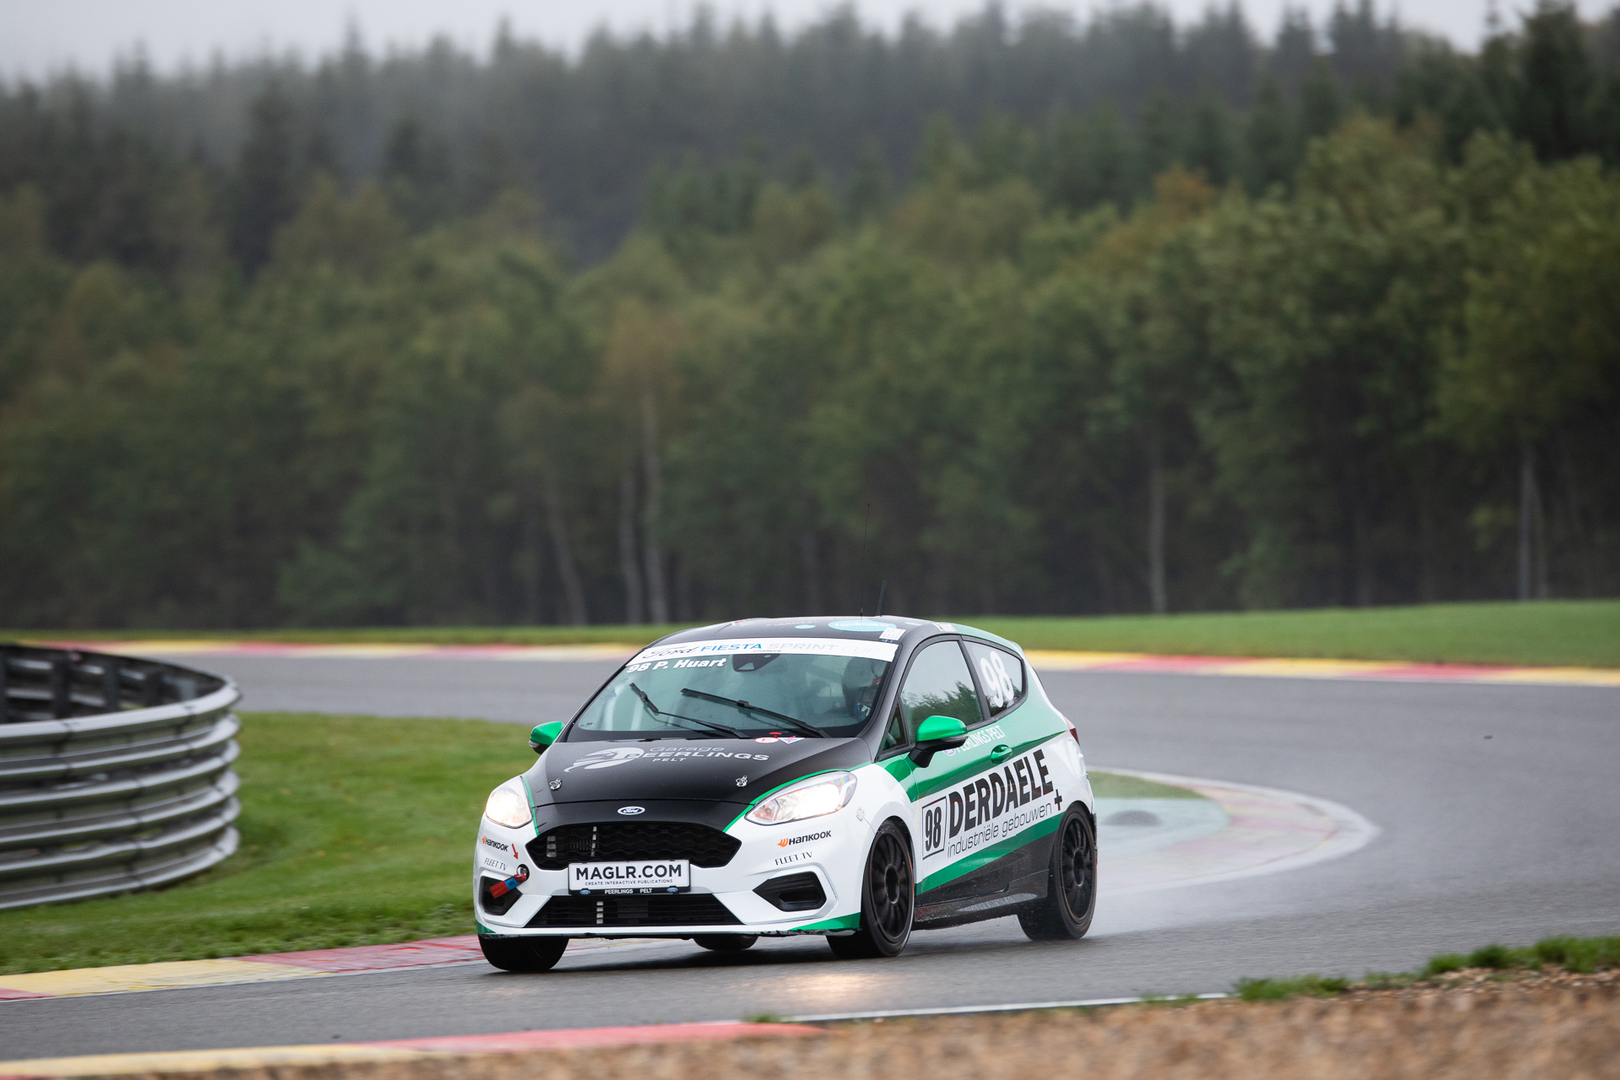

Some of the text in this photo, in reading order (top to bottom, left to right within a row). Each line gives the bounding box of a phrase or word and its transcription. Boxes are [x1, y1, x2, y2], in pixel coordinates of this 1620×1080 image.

[626, 658, 728, 673] 98 P. Huart
[700, 643, 762, 652] FIESTA
[767, 642, 839, 651] SPRINT
[842, 644, 880, 654] CUP
[980, 650, 1015, 708] 98
[948, 749, 1054, 839] DERDAELE
[925, 806, 942, 851] 98
[947, 802, 1053, 858] industriële gebouwen
[576, 864, 681, 880] MAGLR.COM
